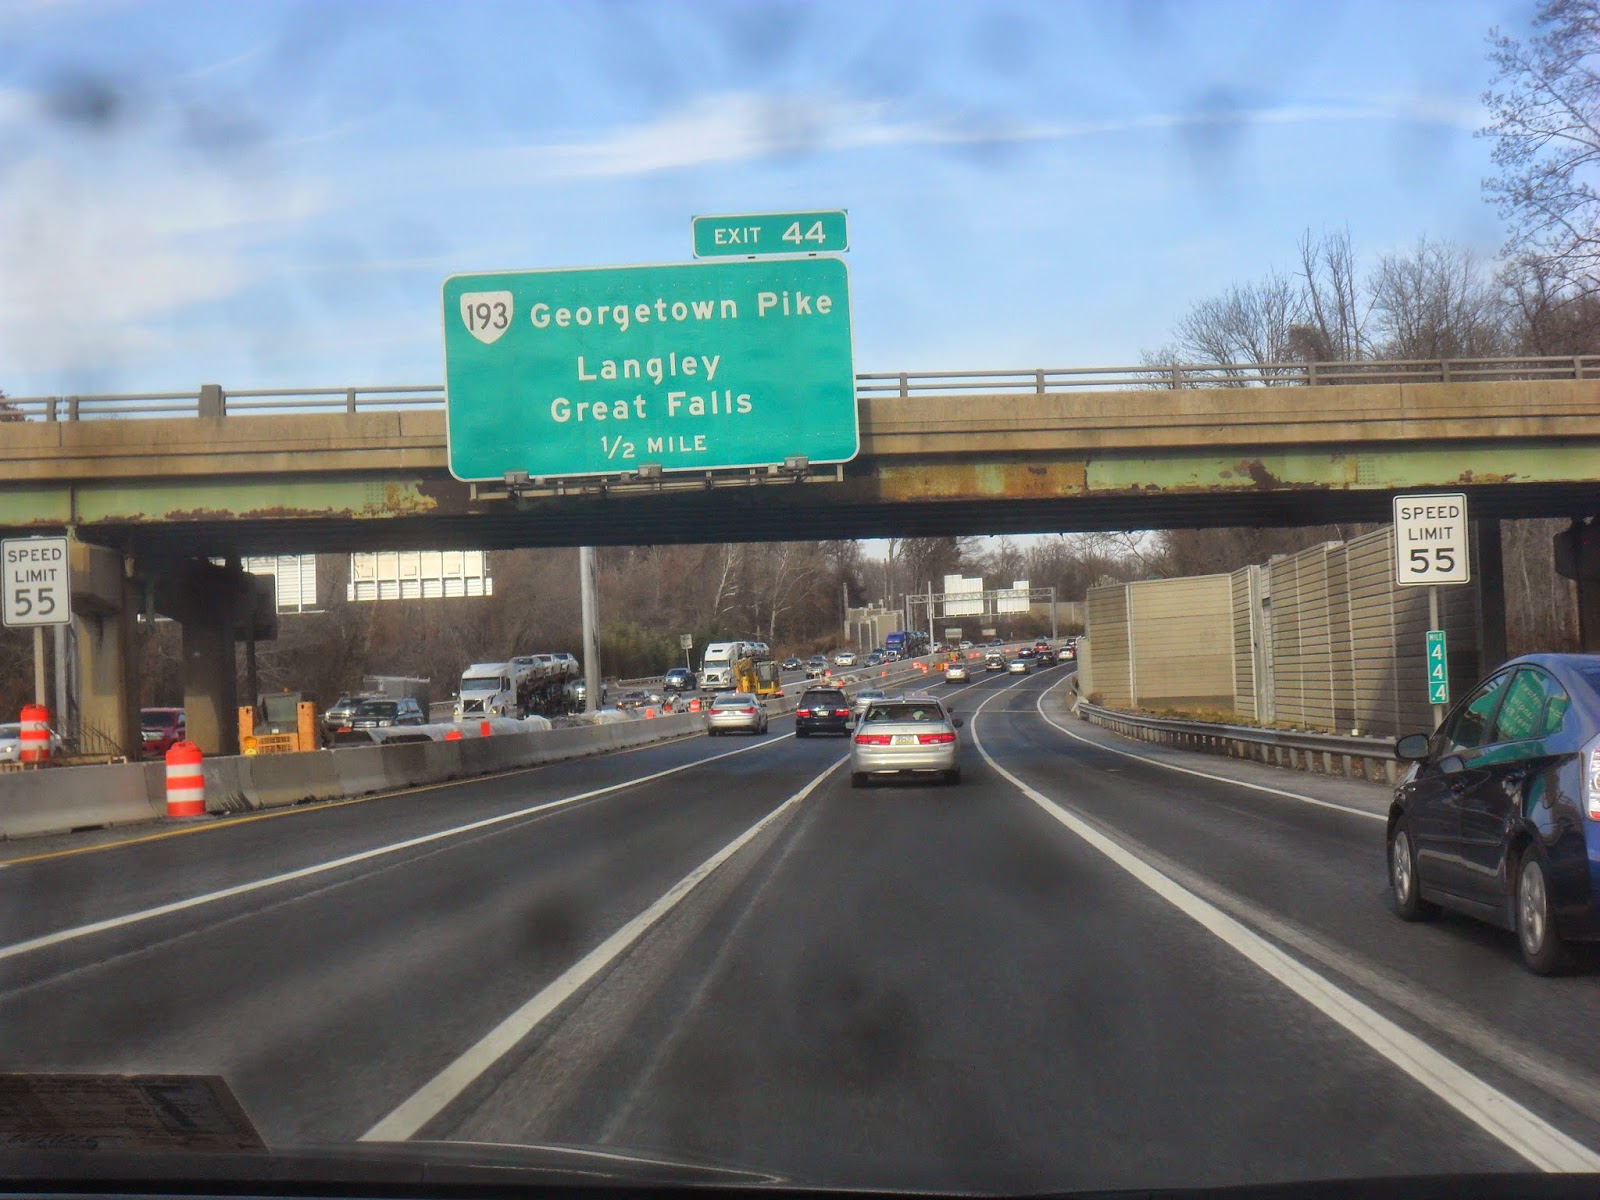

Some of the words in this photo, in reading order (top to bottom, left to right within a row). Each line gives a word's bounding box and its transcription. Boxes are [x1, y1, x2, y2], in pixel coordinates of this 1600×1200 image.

[714, 227, 761, 245] EXIT
[781, 220, 826, 245] 44
[466, 301, 509, 332] 193
[530, 298, 738, 332] Georgetown
[757, 291, 833, 317] Pike
[577, 352, 721, 385] Langley
[551, 394, 647, 423] Great
[667, 389, 753, 418] Falls
[601, 435, 635, 460] 1/2
[648, 435, 707, 454] MILE
[1401, 505, 1460, 520] SPEED
[1408, 526, 1454, 541] LIMIT
[8, 548, 62, 563] SPEED
[1410, 547, 1455, 574] 55
[15, 568, 57, 583] LIMIT
[15, 587, 56, 617] 55
